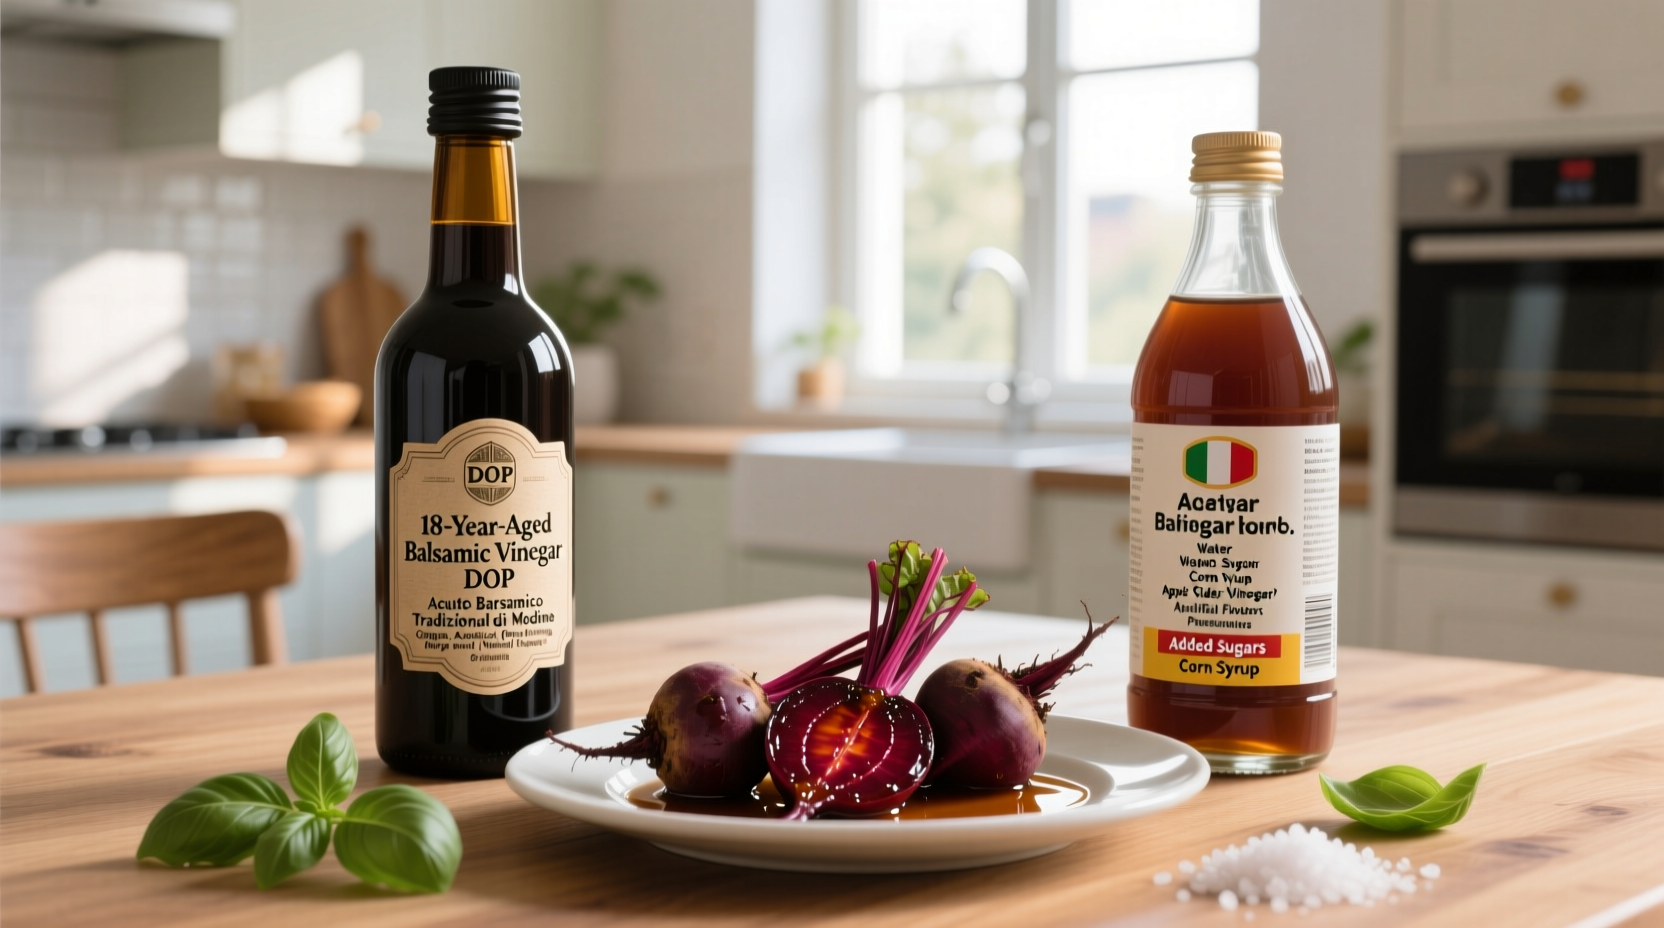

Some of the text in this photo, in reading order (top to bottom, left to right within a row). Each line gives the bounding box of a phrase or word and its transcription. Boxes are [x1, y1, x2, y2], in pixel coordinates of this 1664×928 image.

[467, 466, 513, 483] DOP
[421, 512, 552, 541] 18-Year-Aged
[405, 541, 563, 567] Balsamic Vinegar
[464, 568, 515, 589] DOP
[1189, 570, 1218, 583] Corn
[476, 594, 543, 610] Barsamico
[412, 612, 490, 627] Tradizional
[493, 613, 507, 627] di
[1169, 636, 1266, 658] Added Sugars
[1179, 658, 1260, 679] Corn Syrup
